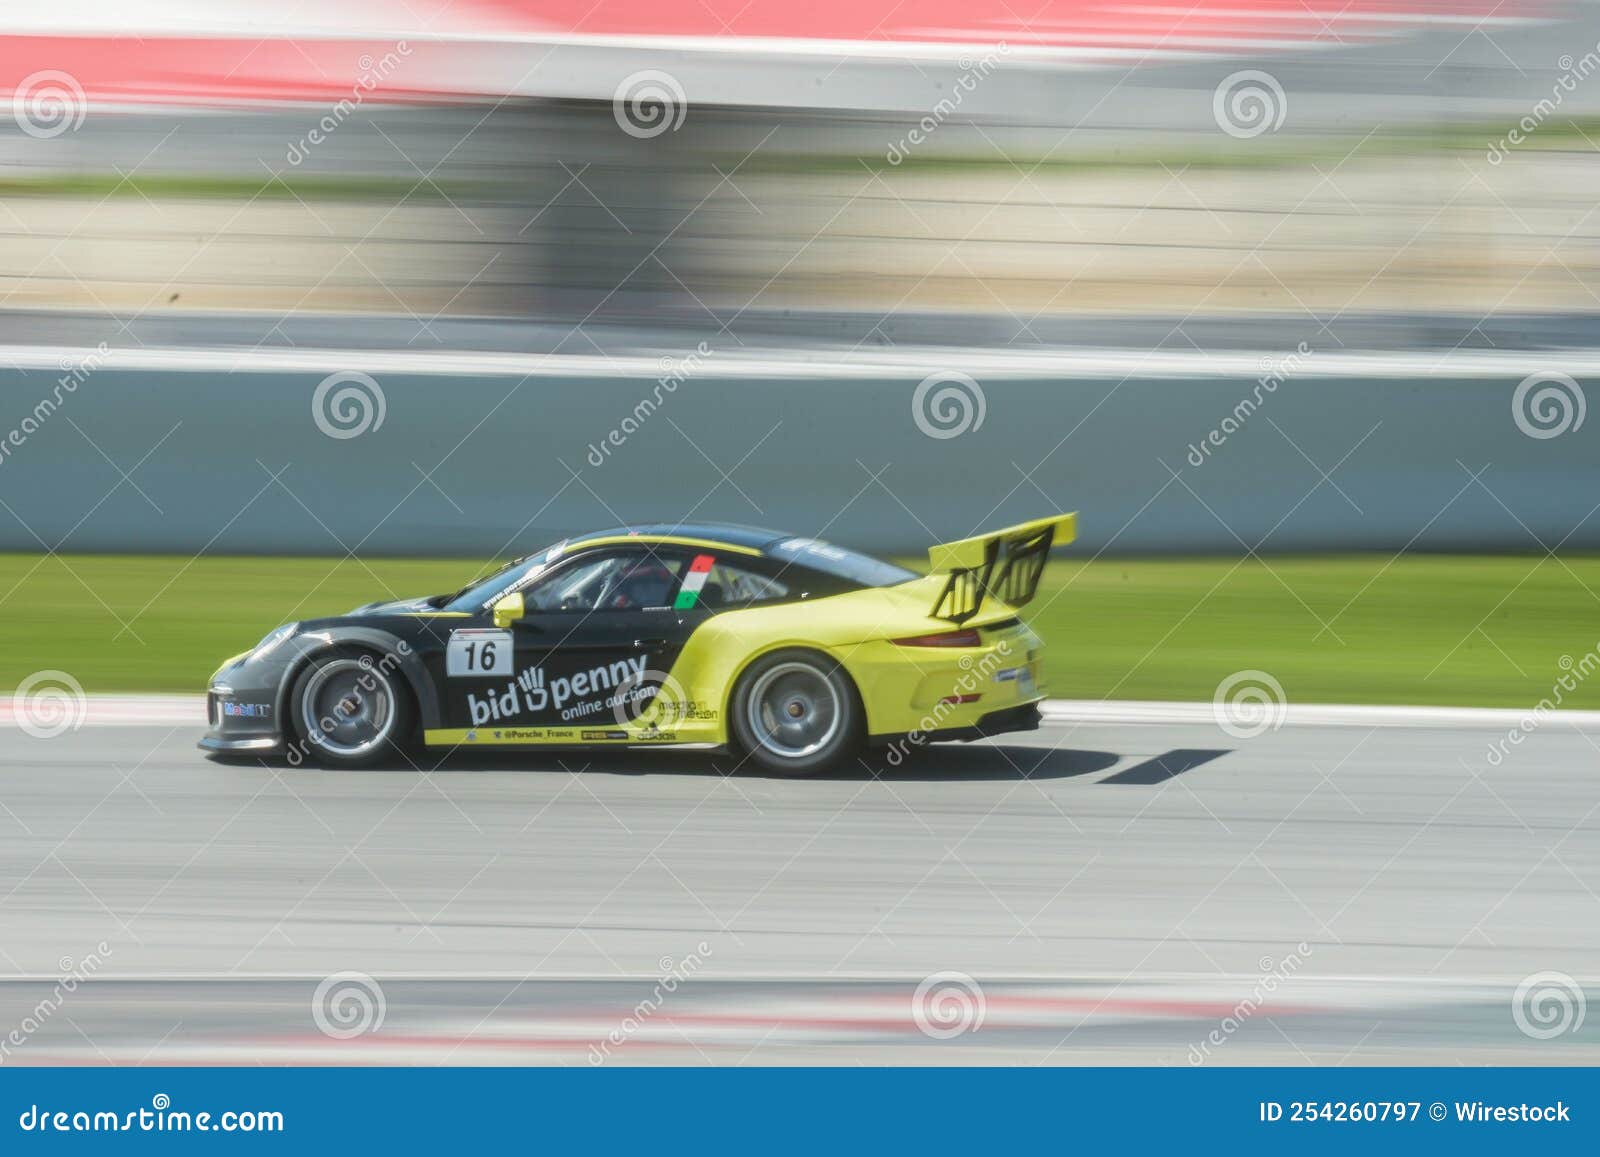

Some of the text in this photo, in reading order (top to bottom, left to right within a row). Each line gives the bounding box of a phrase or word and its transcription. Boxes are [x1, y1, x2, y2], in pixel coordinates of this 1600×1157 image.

[464, 641, 497, 671] 16
[467, 654, 648, 726] bid penny
[561, 684, 657, 721] online auction
